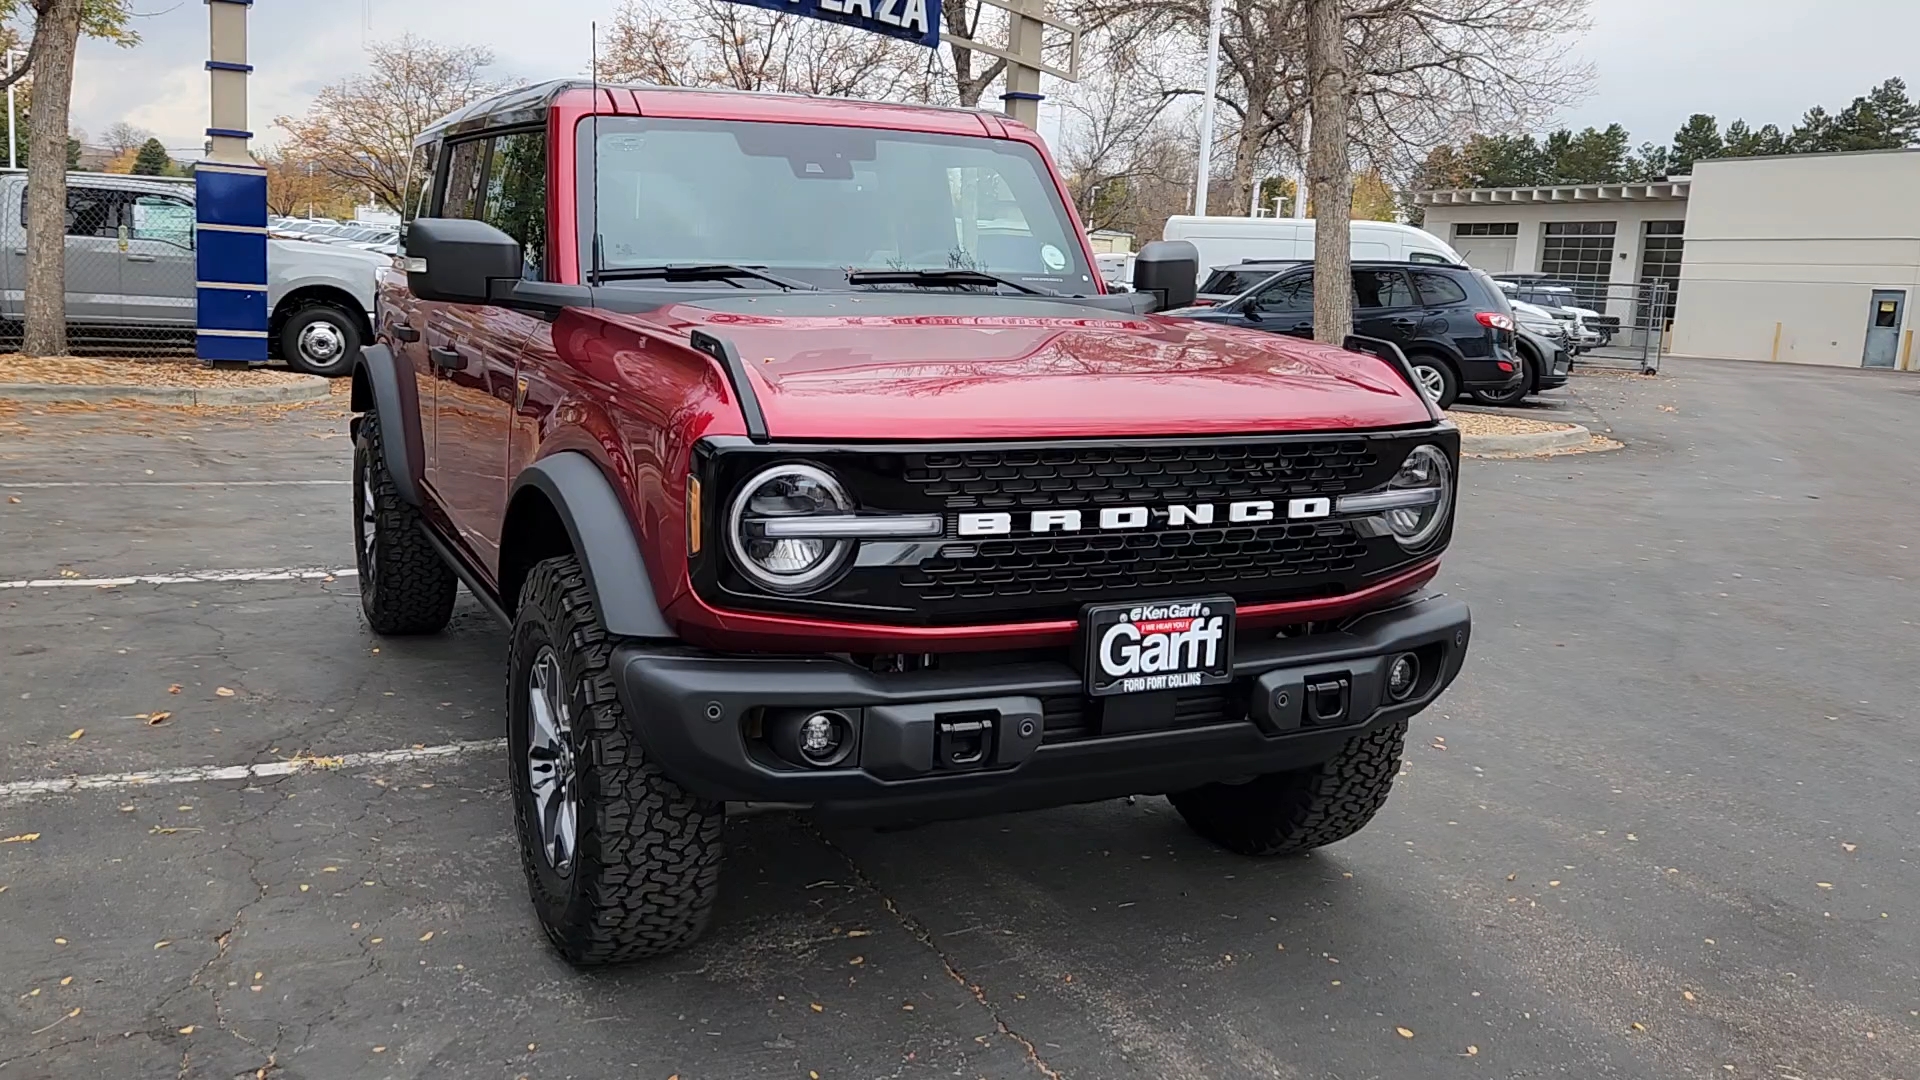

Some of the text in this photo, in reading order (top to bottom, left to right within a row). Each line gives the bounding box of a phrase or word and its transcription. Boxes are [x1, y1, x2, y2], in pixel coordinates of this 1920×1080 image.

[790, 0, 929, 33] AZA
[958, 497, 1330, 535] BRONCO
[1142, 602, 1202, 620] Ken Garff
[1146, 623, 1155, 631] WE
[1173, 621, 1185, 629] YOU
[1100, 616, 1223, 676] Garff
[1124, 672, 1202, 692] FORD FORT COLLINS
